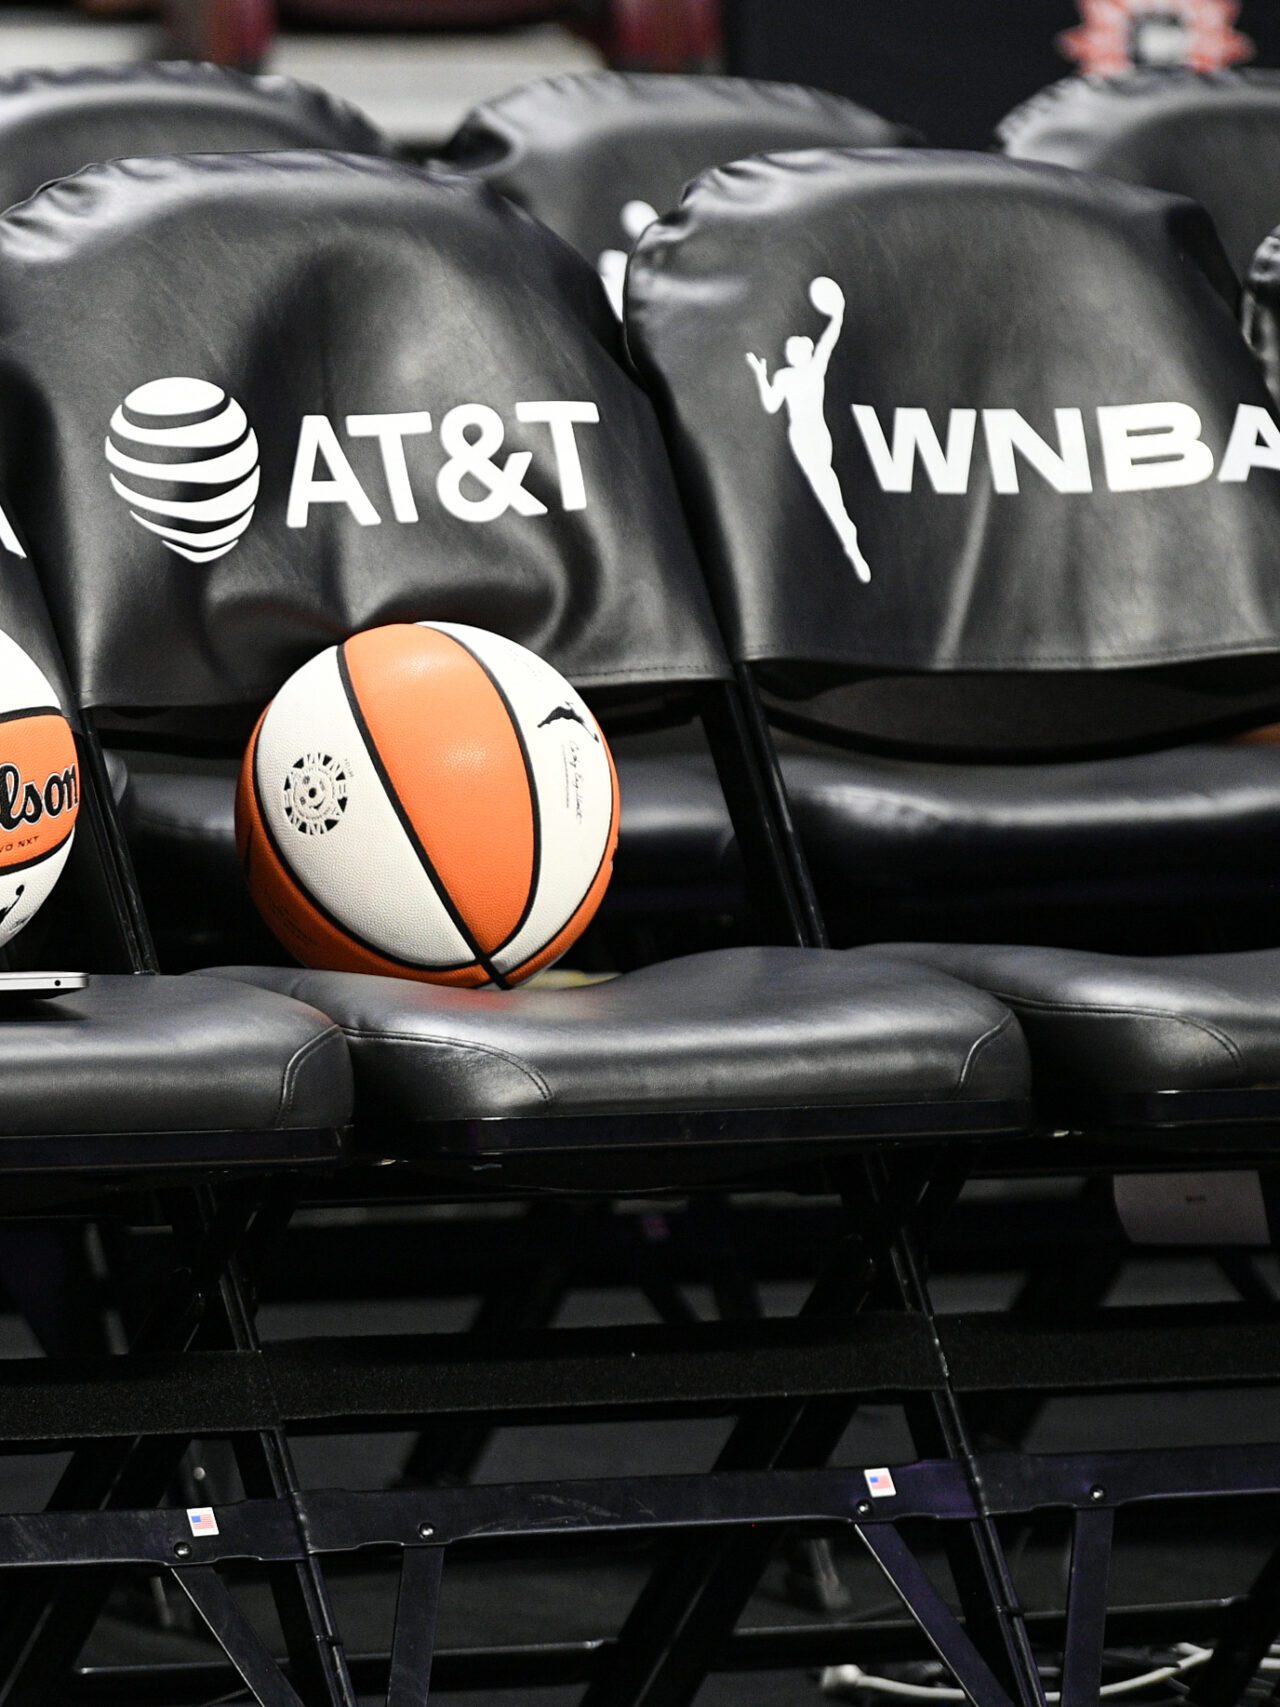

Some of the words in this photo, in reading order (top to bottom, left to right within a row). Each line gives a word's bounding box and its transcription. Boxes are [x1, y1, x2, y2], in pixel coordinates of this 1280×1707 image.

[286, 401, 600, 528] AT&T
[851, 401, 1280, 494] WNBA
[18, 836, 39, 848] NXT
